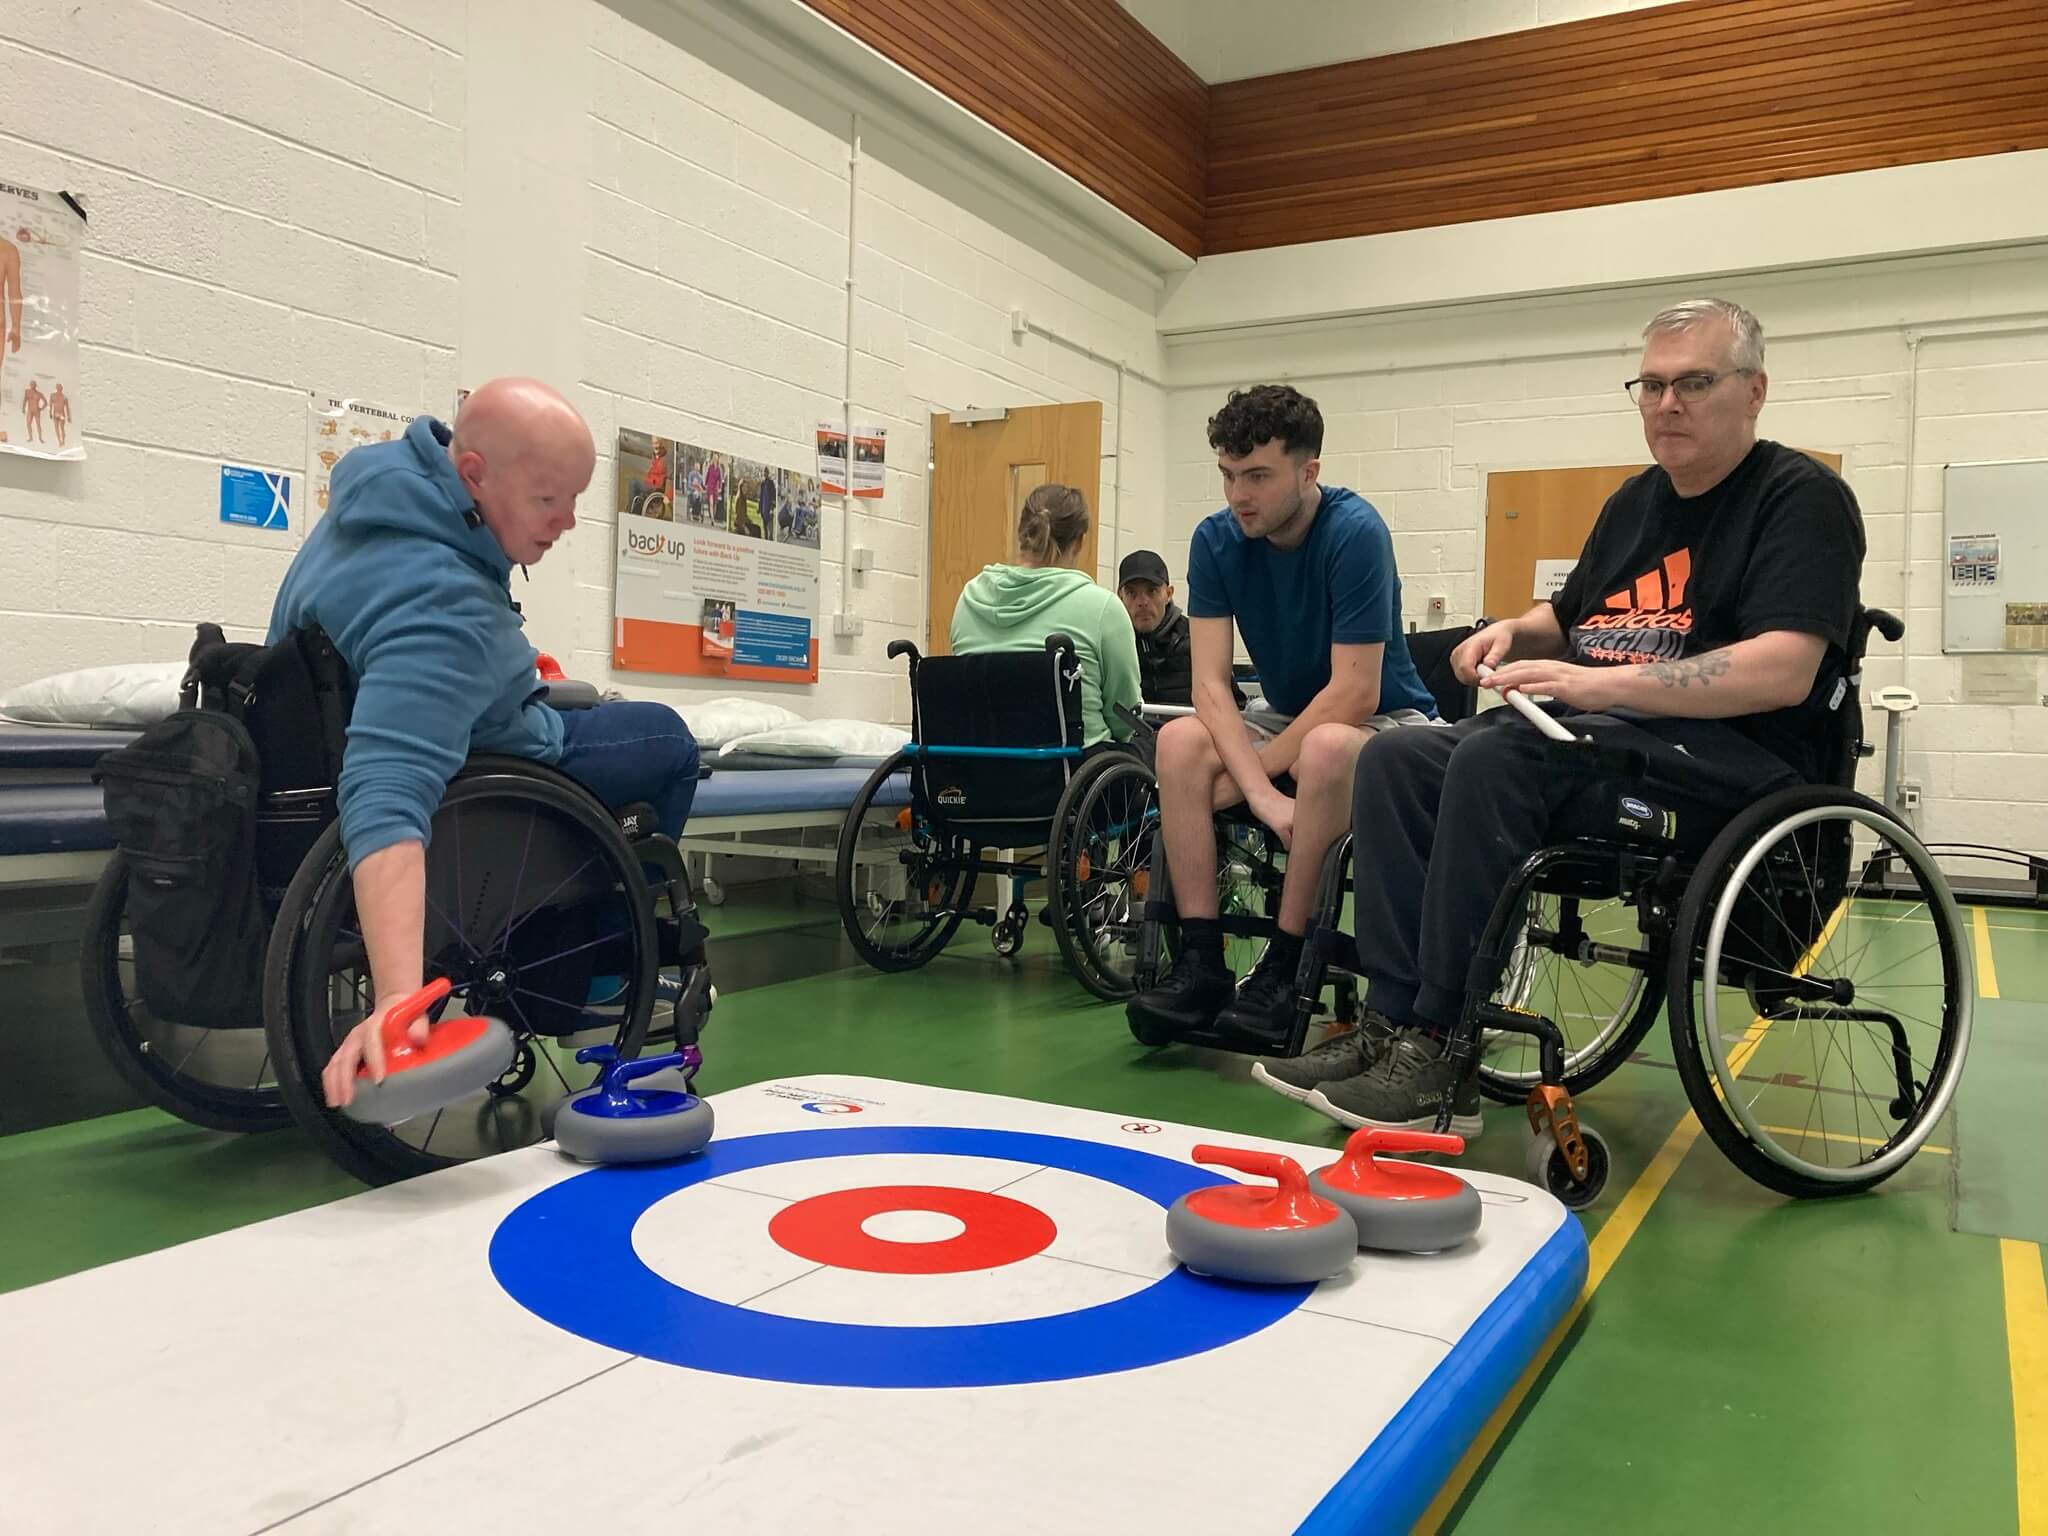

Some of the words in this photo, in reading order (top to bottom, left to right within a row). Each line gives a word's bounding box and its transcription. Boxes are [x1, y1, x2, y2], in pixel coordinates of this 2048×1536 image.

[349, 403, 398, 420] VERTEBRAL
[628, 528, 664, 554] back
[667, 539, 686, 560] up
[693, 536, 705, 545] Look
[707, 540, 726, 549] forward
[693, 547, 707, 556] future
[720, 551, 732, 559] Back
[1578, 609, 1692, 632] adidas
[937, 795, 967, 805] QUICKIE
[623, 815, 637, 827] JAY
